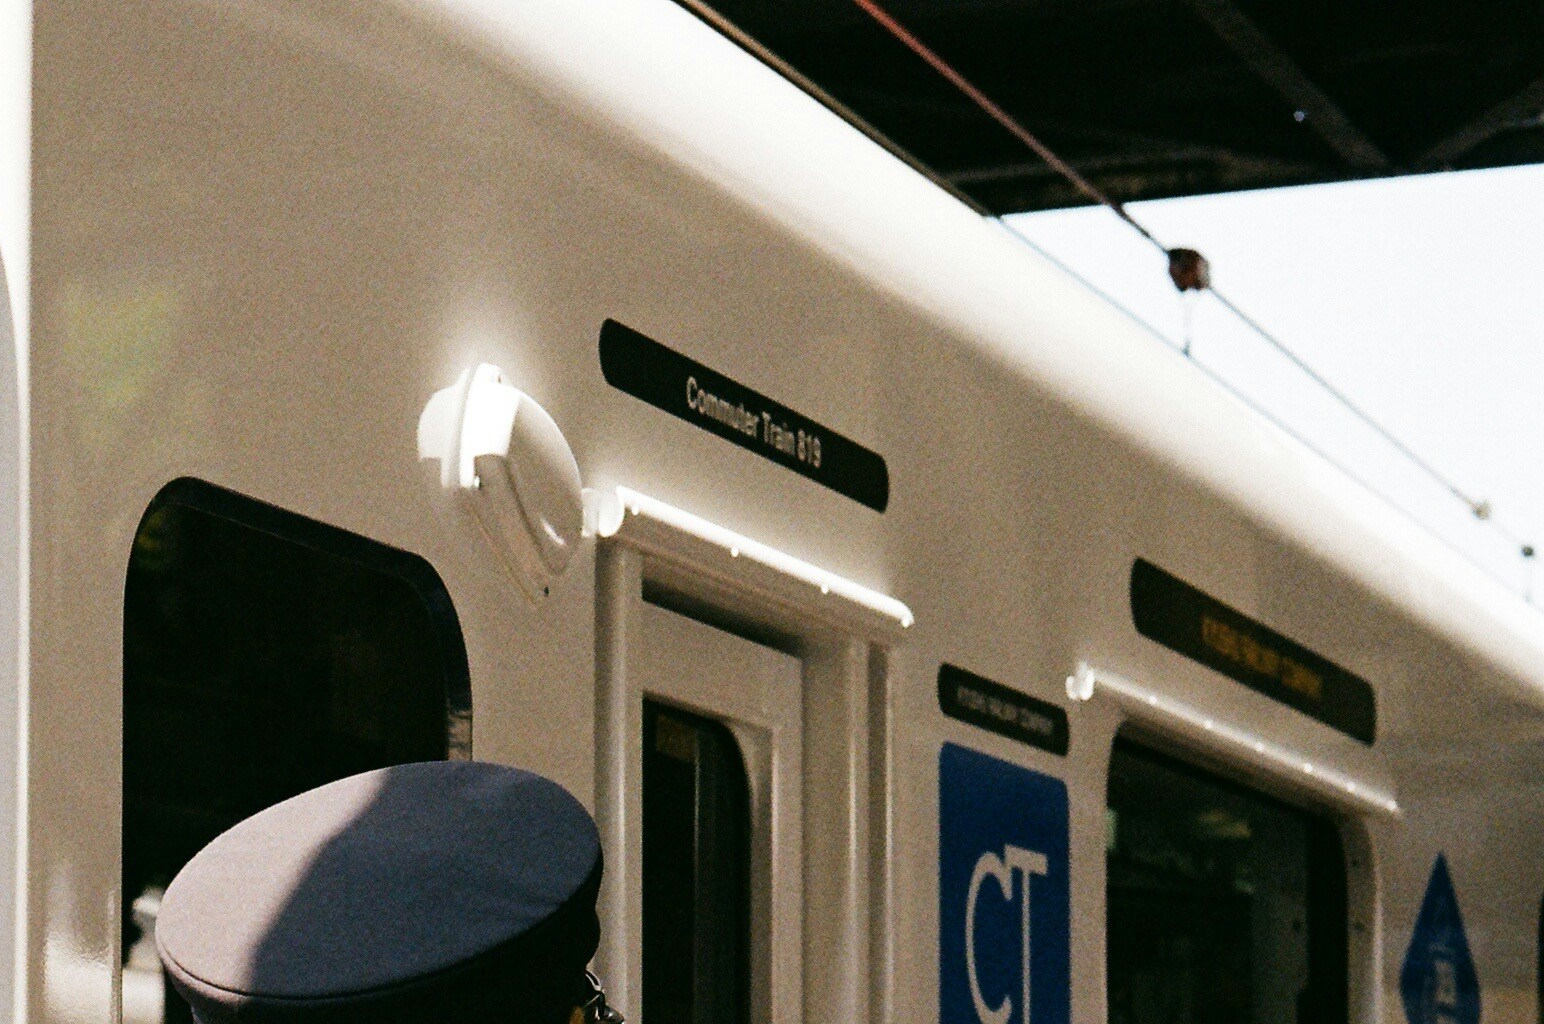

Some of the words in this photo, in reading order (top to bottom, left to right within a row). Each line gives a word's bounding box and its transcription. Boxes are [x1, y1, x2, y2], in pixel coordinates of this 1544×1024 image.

[685, 375, 759, 438] Commuter
[762, 411, 796, 457] Train
[797, 429, 822, 469] 819
